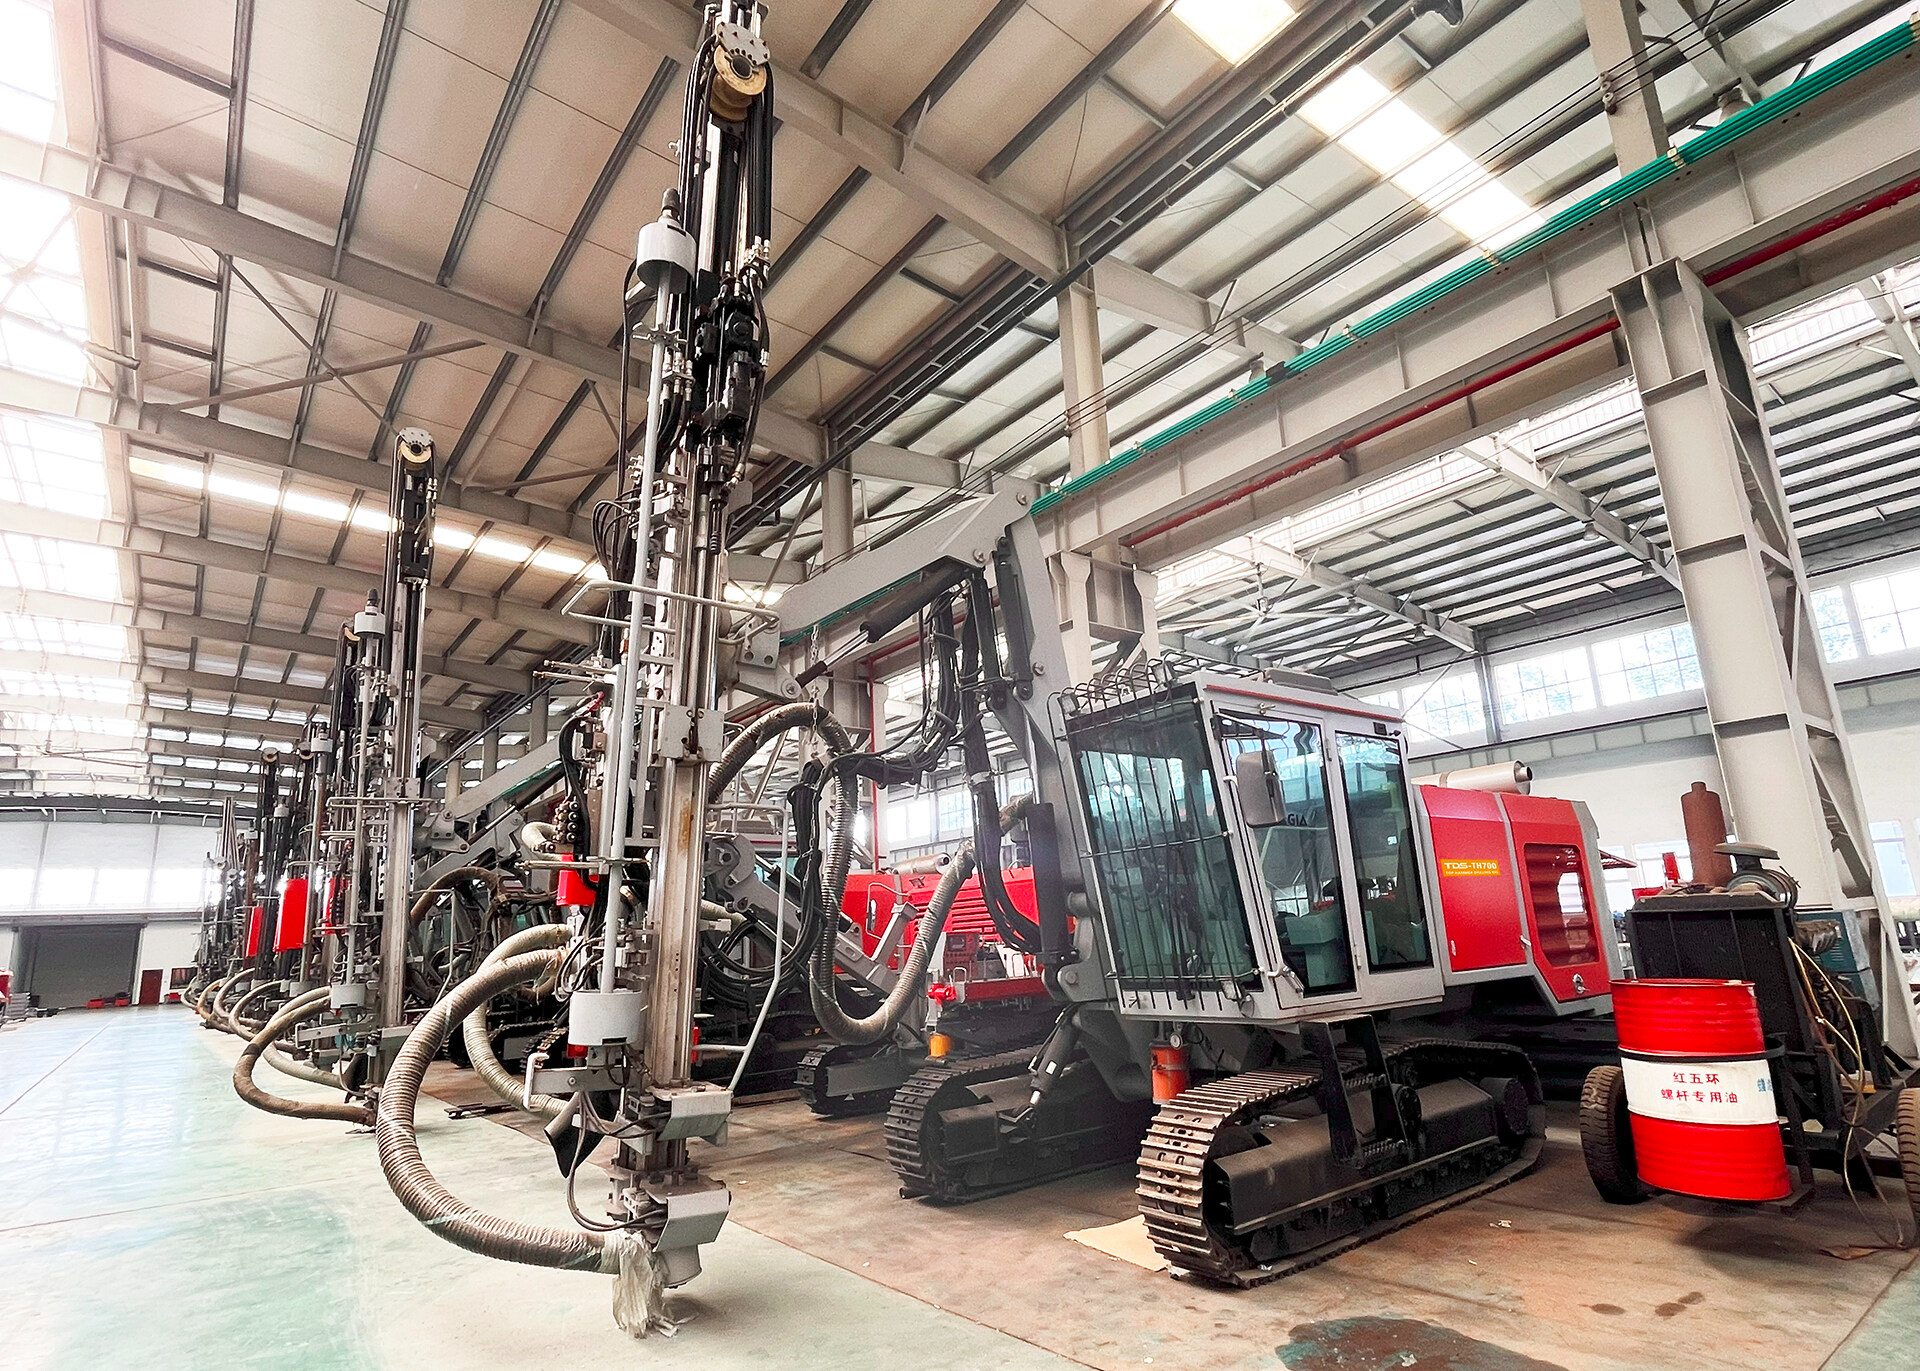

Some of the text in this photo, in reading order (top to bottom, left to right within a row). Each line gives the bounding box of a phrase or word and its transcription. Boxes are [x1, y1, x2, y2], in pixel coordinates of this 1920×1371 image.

[1673, 1072, 1720, 1085] 红五环
[1661, 1088, 1738, 1103] 螺杆专用油
